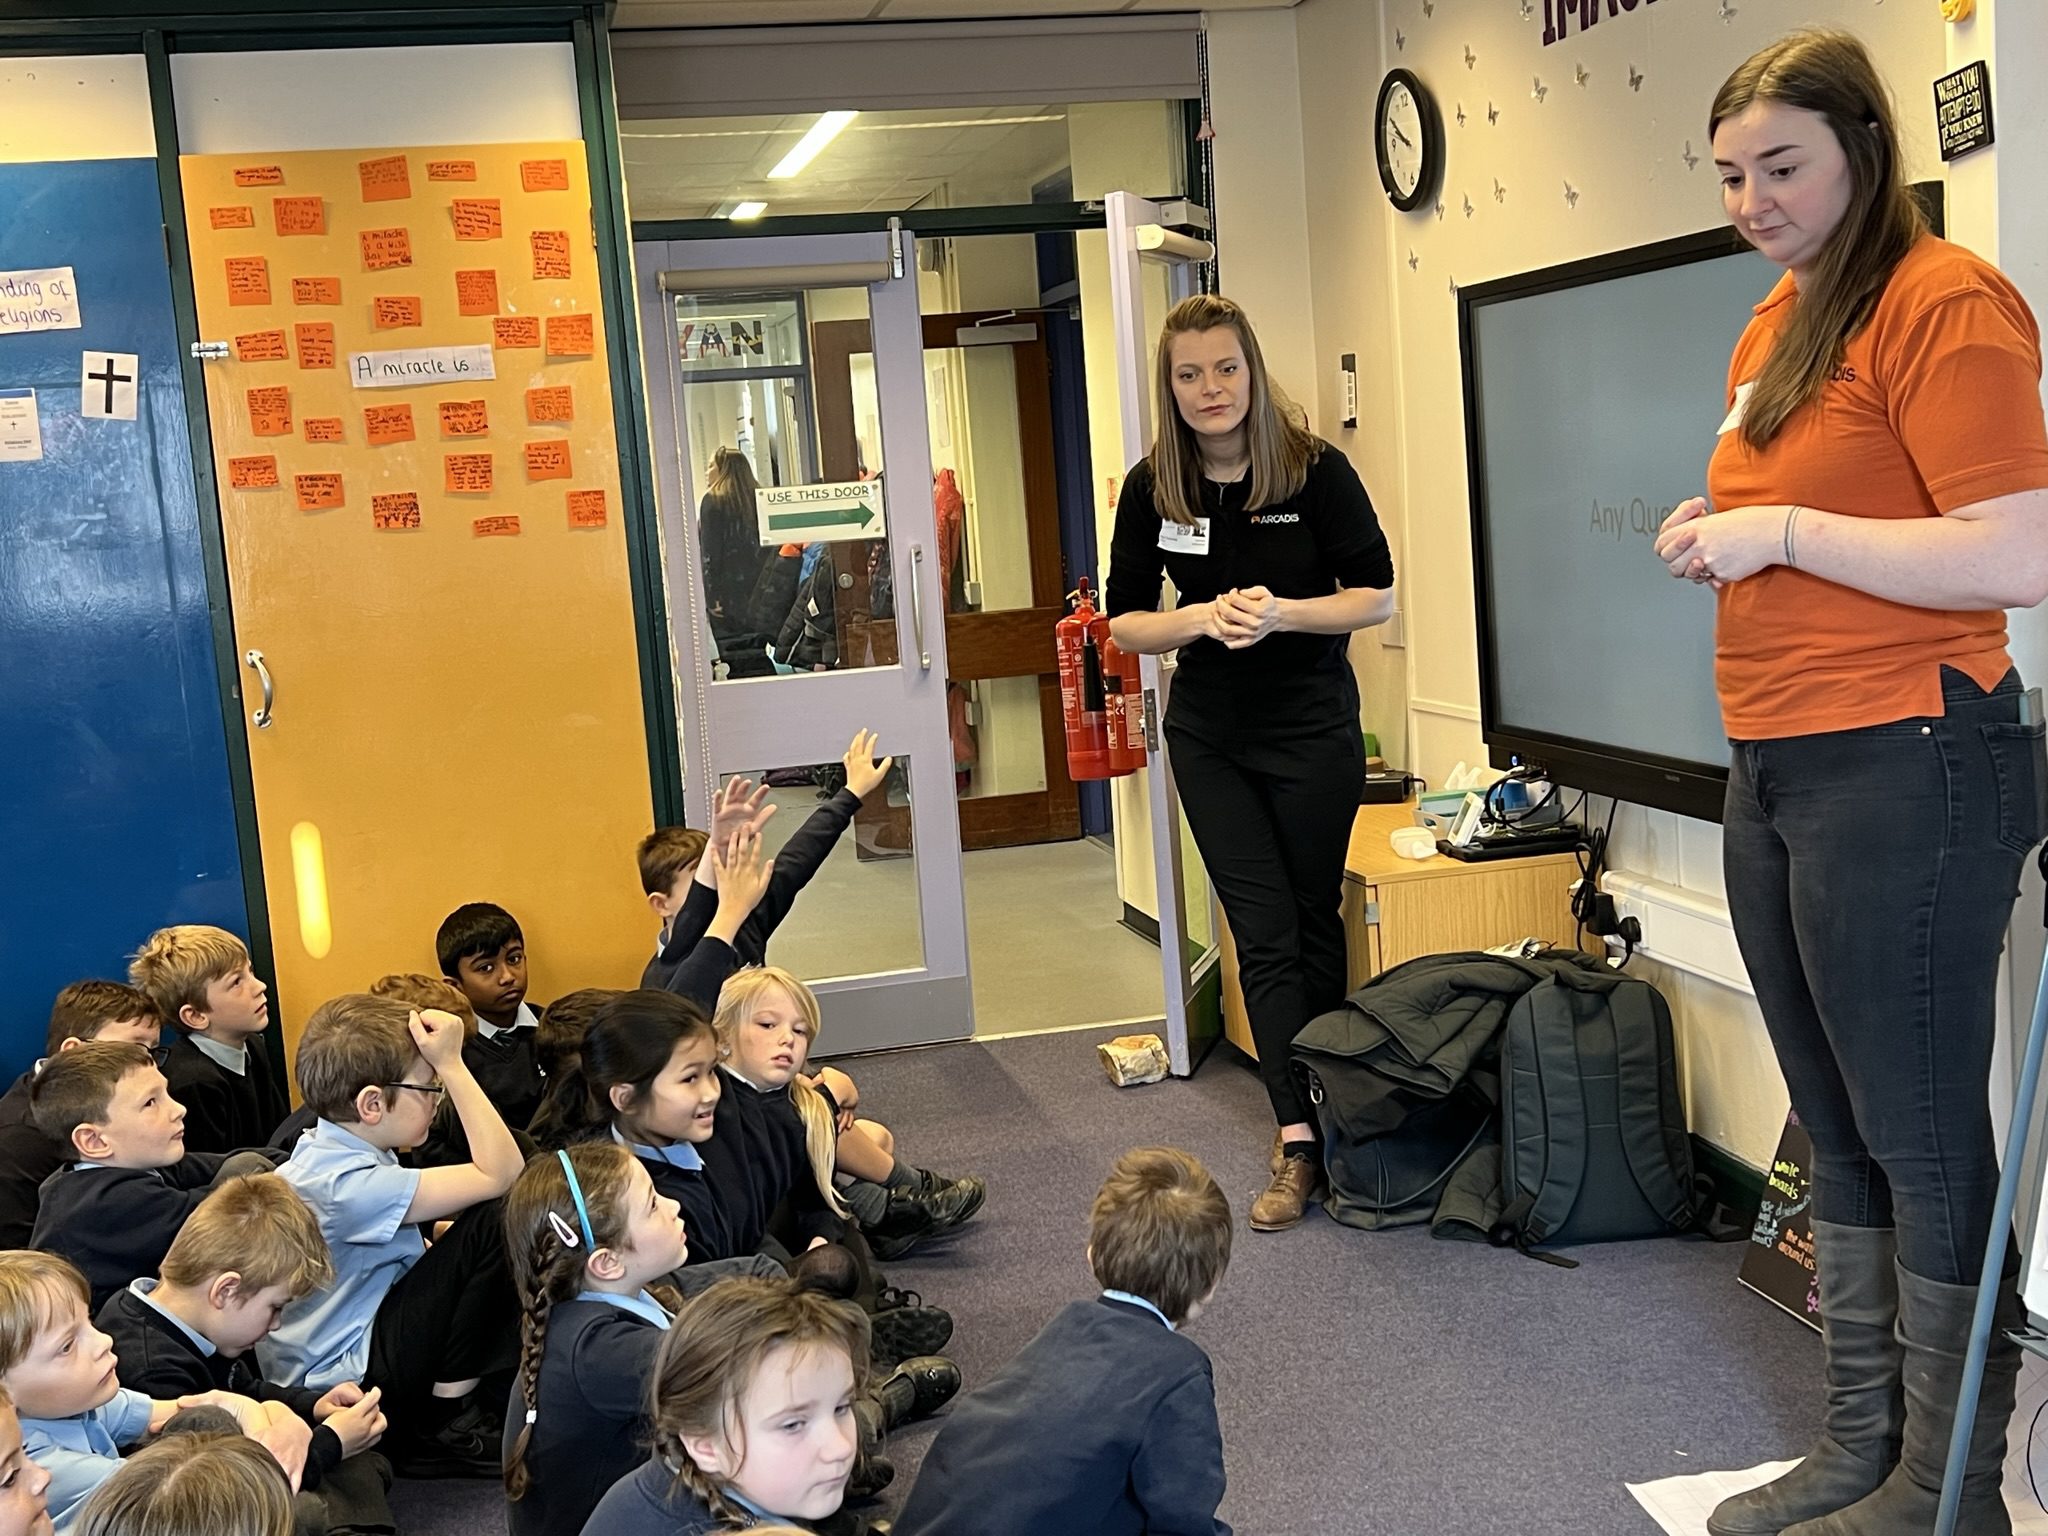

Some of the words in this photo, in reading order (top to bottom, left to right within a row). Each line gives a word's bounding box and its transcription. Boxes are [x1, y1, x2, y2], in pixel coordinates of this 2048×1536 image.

[1401, 92, 1409, 108] 12
[49, 280, 71, 301] of
[356, 355, 373, 379] A
[383, 359, 446, 376] miracle
[767, 490, 792, 503] USE
[798, 487, 830, 501] THIS
[834, 485, 869, 498] DOOR
[1260, 513, 1300, 524] ARCADIS
[1590, 498, 1624, 541] Any
